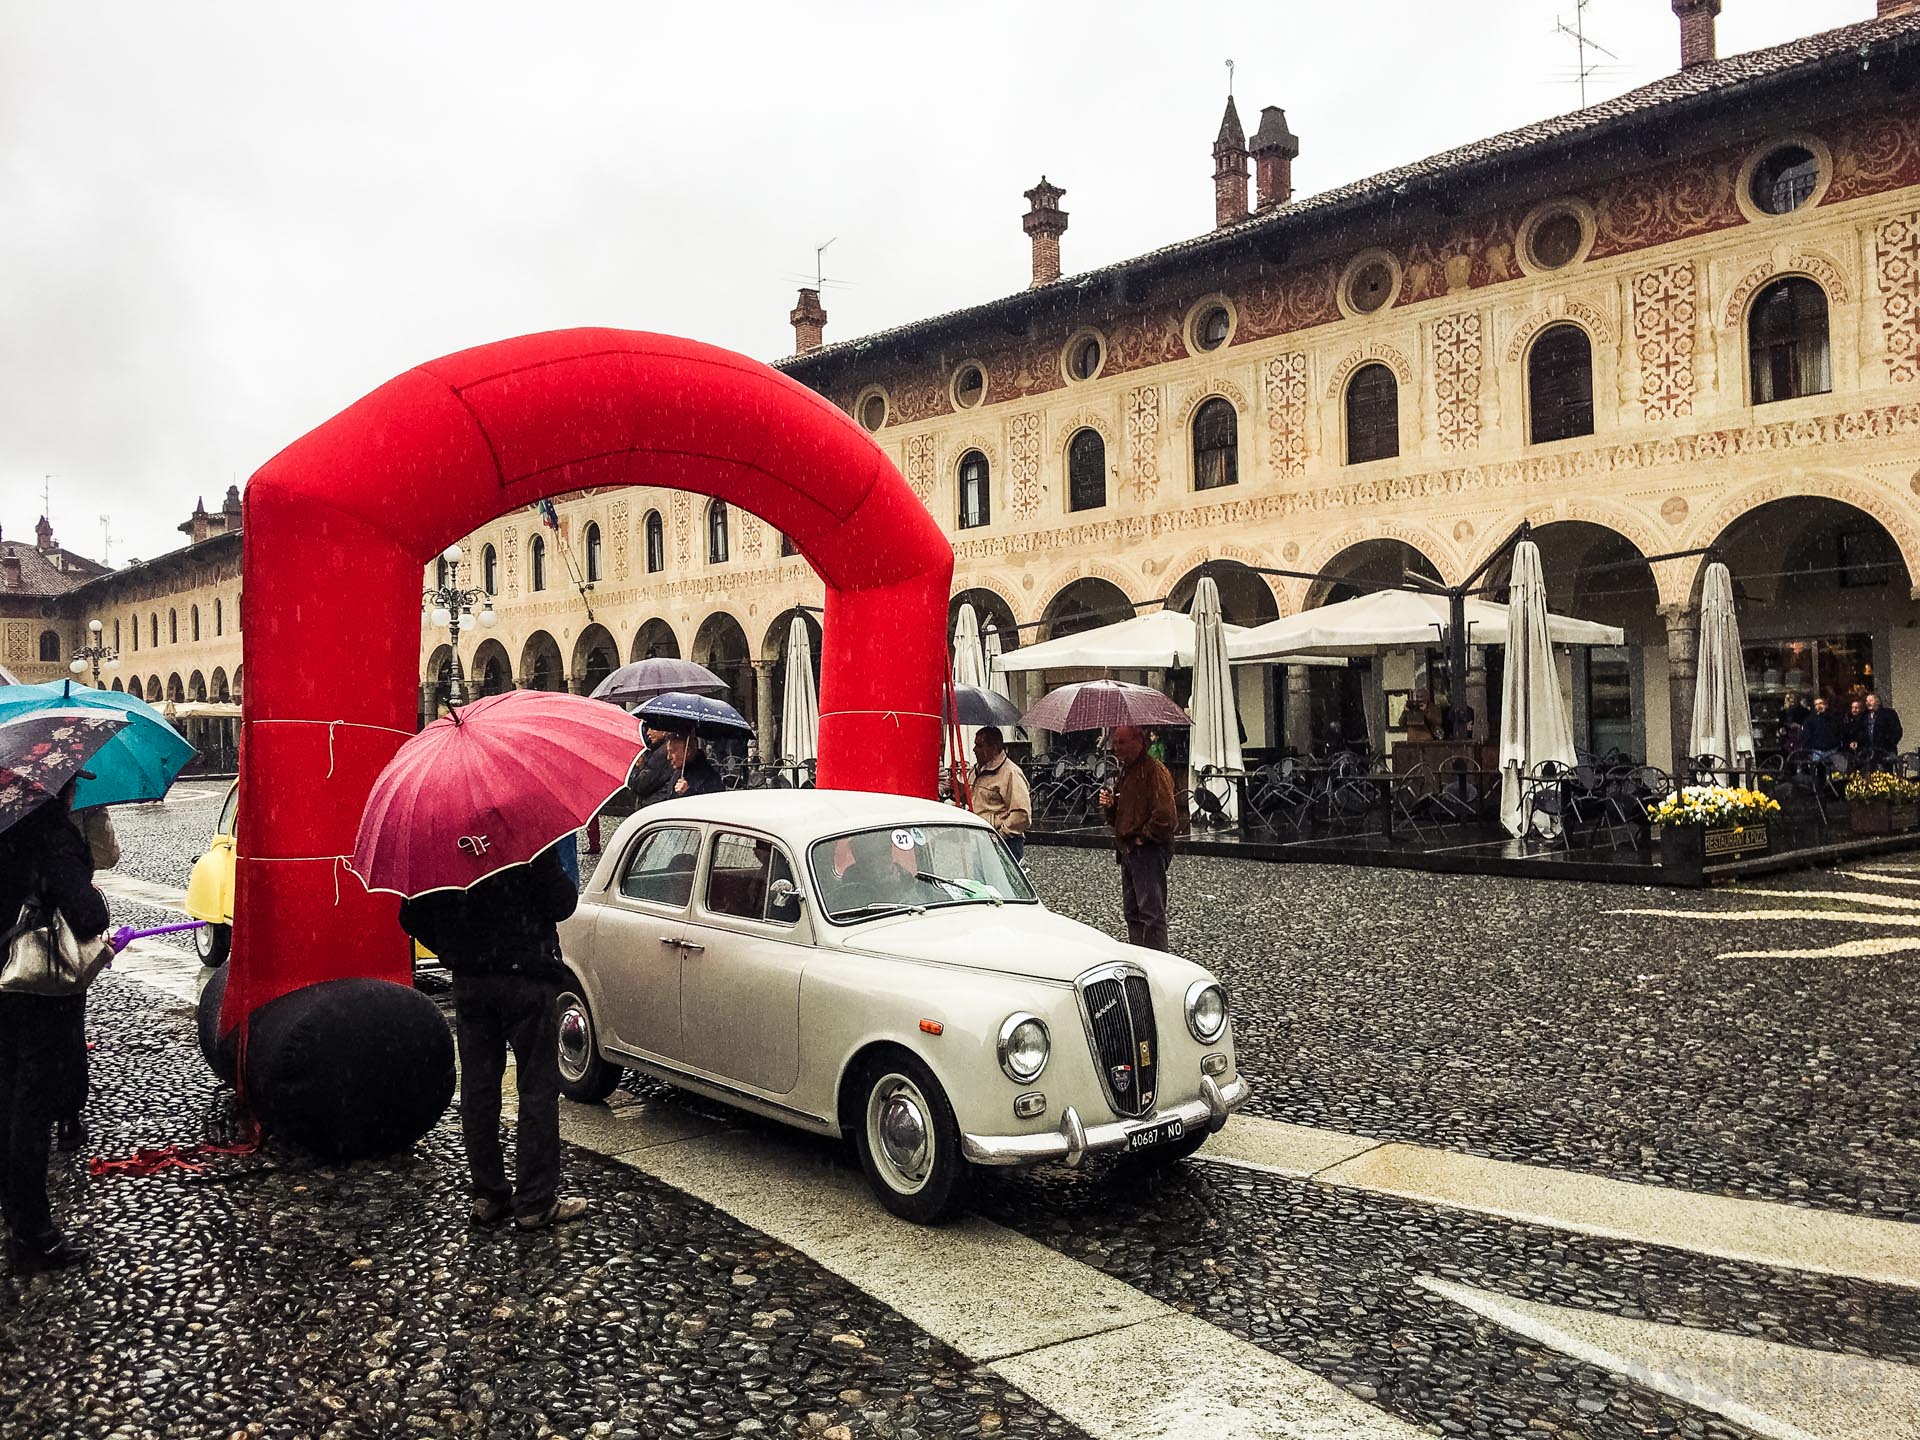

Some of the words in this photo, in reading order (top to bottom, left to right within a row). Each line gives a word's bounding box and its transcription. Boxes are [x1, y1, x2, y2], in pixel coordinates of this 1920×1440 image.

[896, 834, 908, 844] 27
[1131, 1129, 1158, 1148] 40687
[1167, 1122, 1182, 1138] NO
